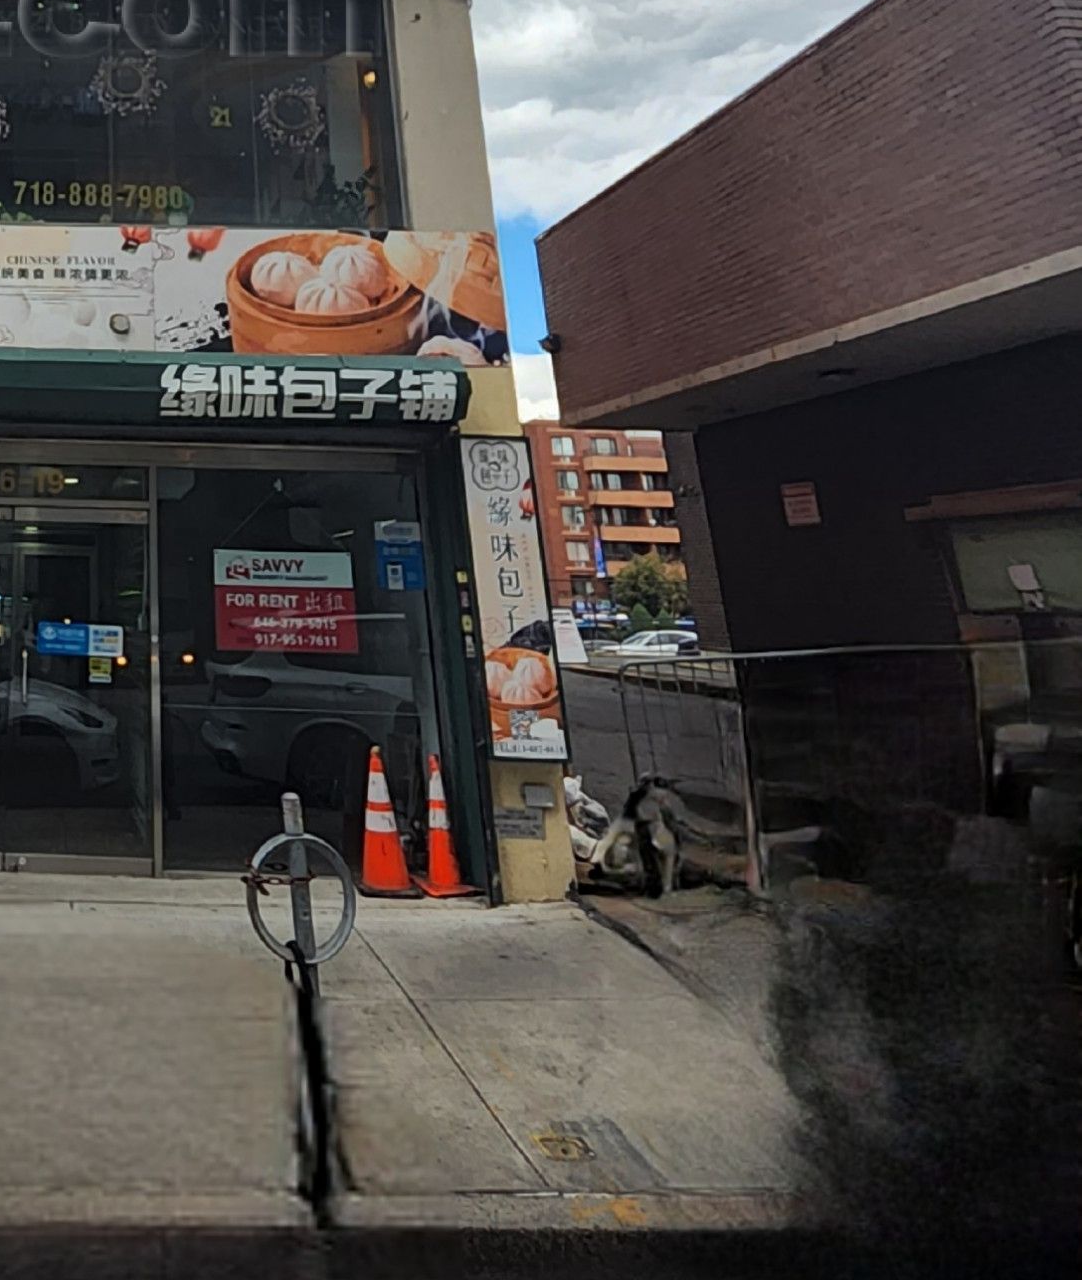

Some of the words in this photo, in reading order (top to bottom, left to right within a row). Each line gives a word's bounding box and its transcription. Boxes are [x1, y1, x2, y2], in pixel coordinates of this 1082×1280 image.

[14, 181, 183, 210] 718-888-7980
[252, 559, 304, 573] SAVVY
[226, 593, 255, 607] FOR
[260, 594, 298, 608] RENT
